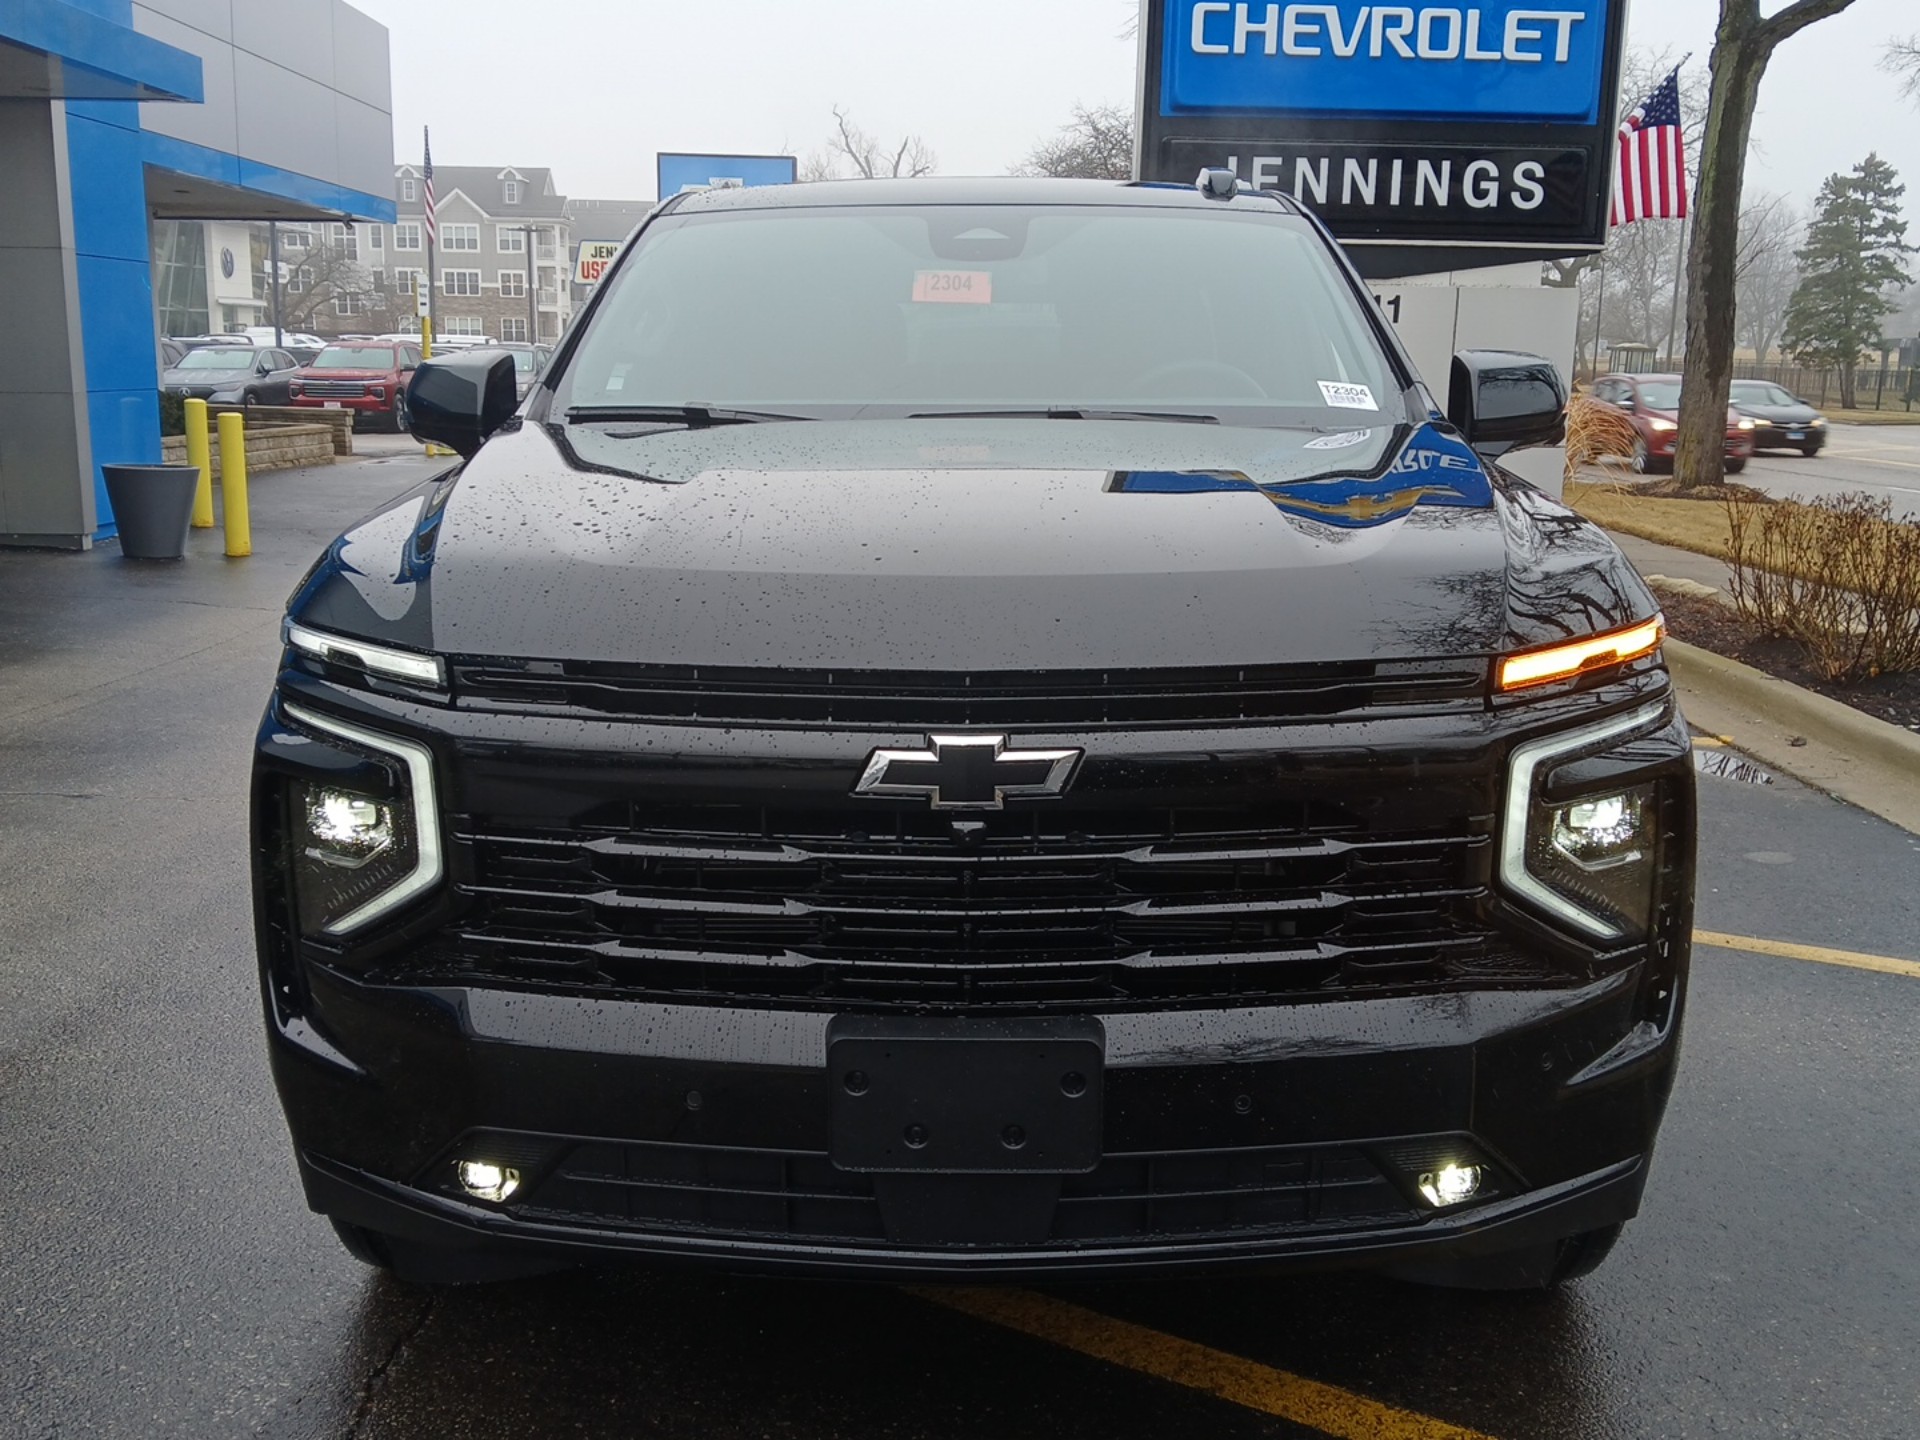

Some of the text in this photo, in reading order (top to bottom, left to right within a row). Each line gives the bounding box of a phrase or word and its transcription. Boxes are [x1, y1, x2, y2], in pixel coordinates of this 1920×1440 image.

[1191, 2, 1585, 62] CHEVROLET
[591, 245, 618, 259] JEN
[1322, 384, 1368, 398] T2304
